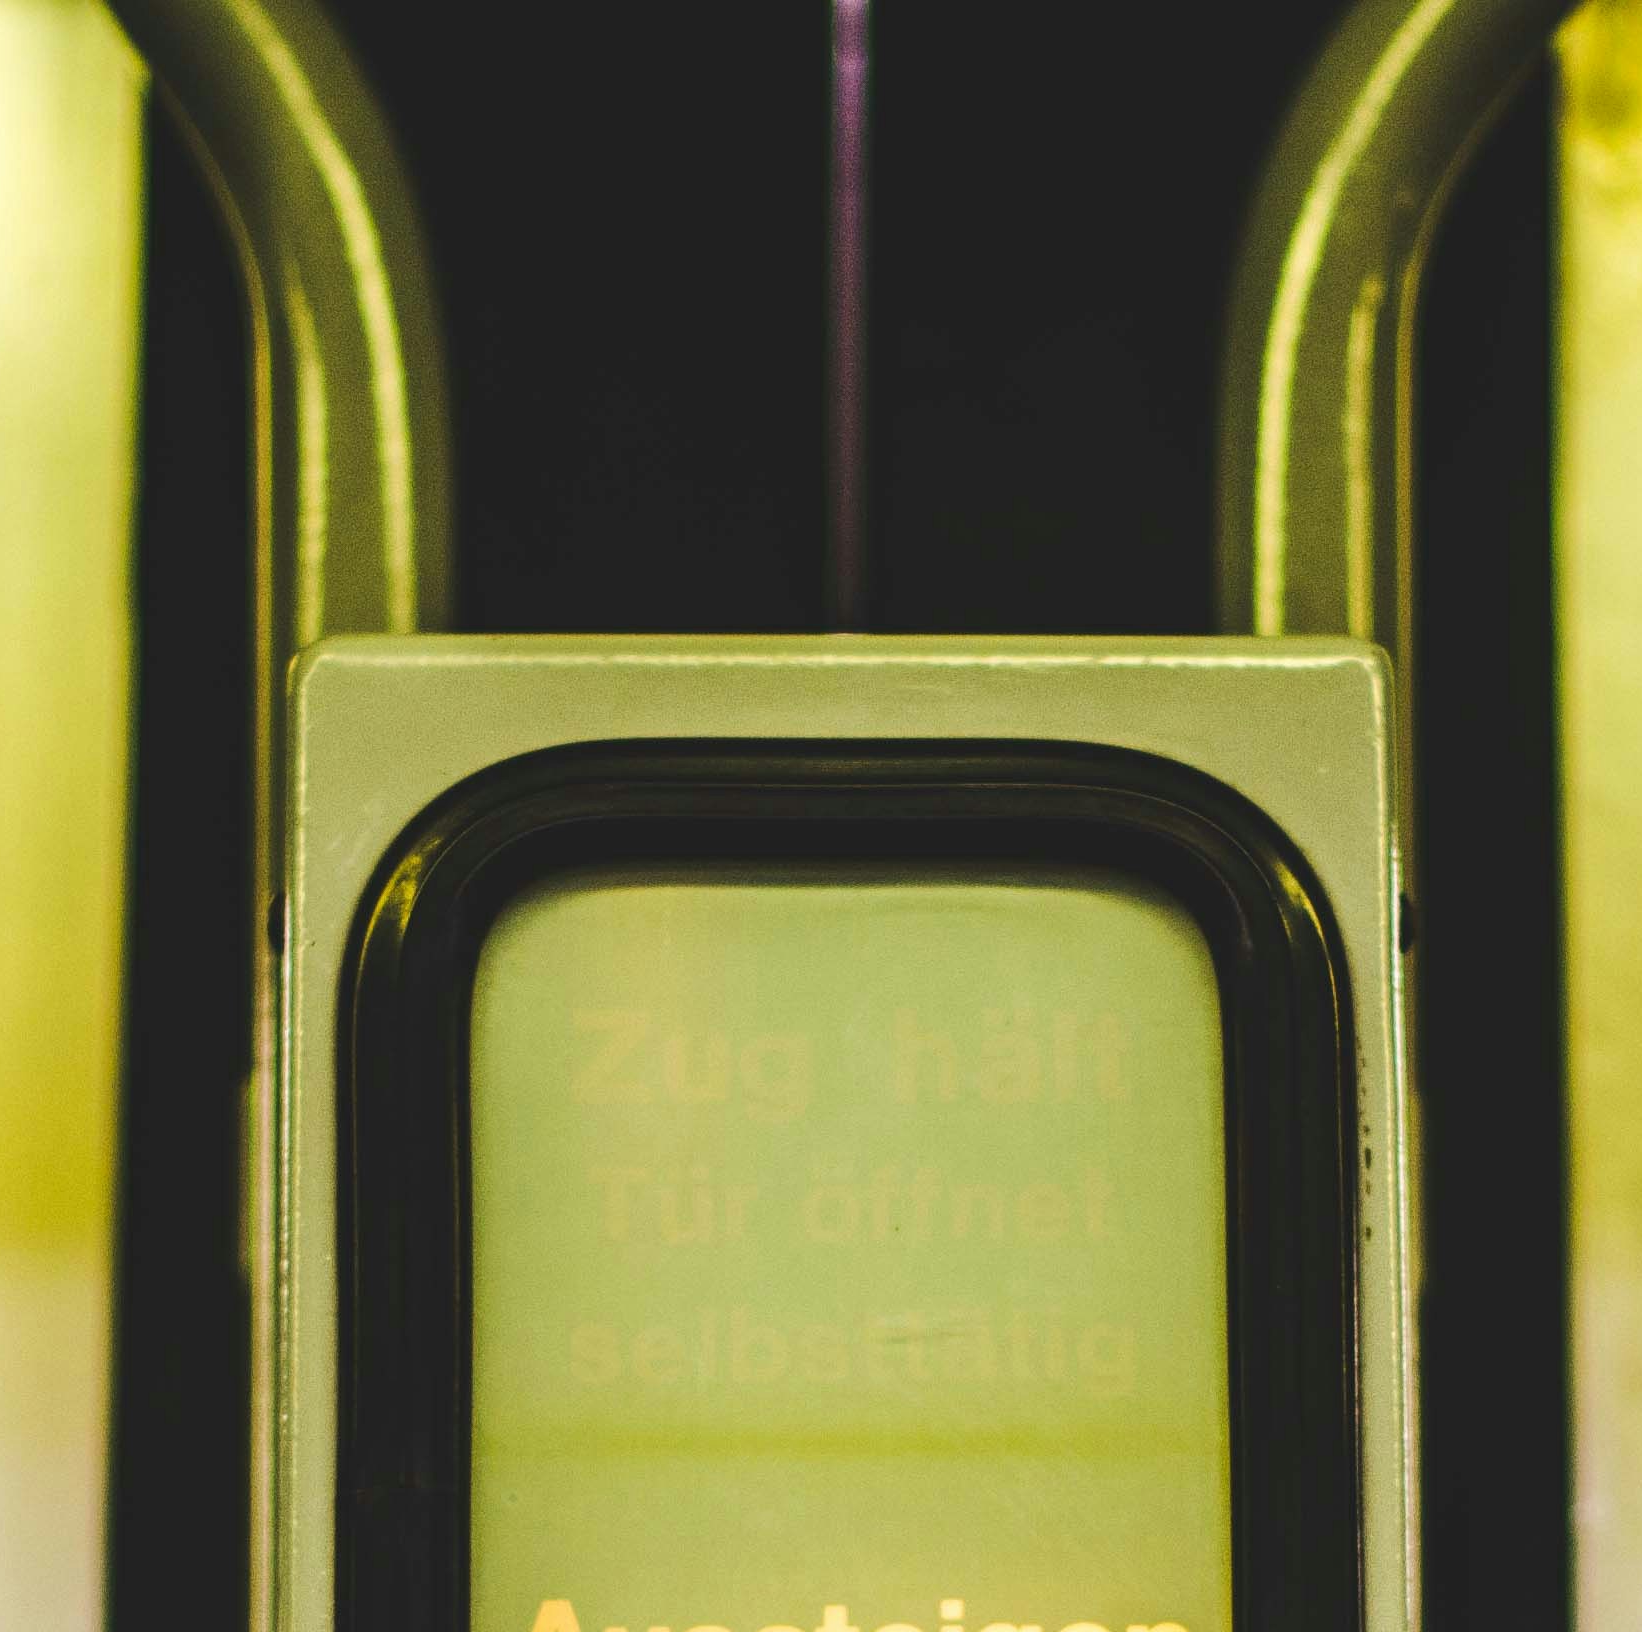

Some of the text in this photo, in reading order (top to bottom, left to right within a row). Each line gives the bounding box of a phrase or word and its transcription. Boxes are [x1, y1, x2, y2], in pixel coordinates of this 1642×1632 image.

[570, 1004, 1132, 1123] Zug hält
[586, 1163, 1116, 1244] Tür öffnet
